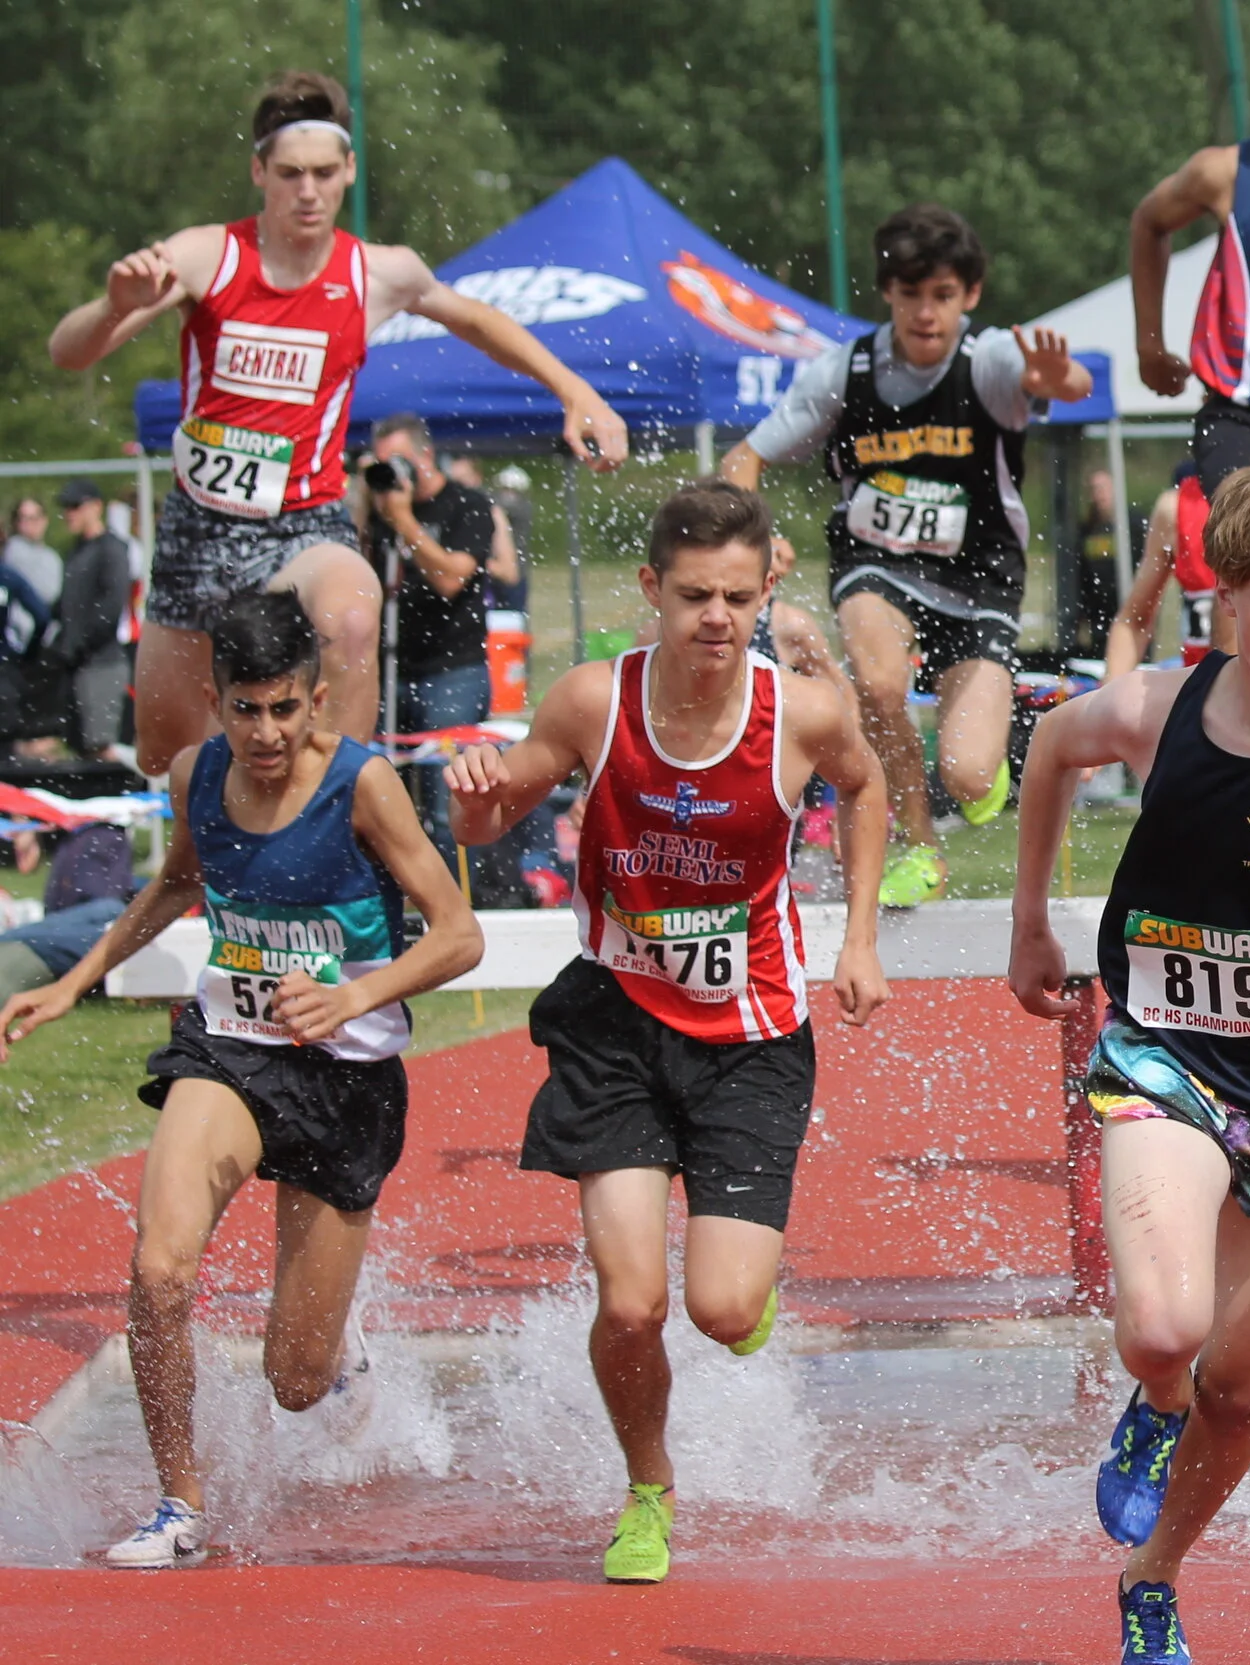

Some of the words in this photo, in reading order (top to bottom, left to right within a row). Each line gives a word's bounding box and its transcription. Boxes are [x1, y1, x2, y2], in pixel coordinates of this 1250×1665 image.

[229, 345, 309, 383] CENTRAL
[182, 419, 289, 458] SUBWAY
[188, 446, 260, 501] 224
[869, 470, 964, 504] SUBWAY
[872, 496, 938, 542] 578
[639, 831, 719, 861] SEMI
[603, 847, 746, 884] TOTEMS
[609, 905, 740, 937] SUBWAY
[217, 941, 333, 979] SUBWAY
[612, 954, 628, 968] BC
[632, 958, 646, 973] HS
[231, 975, 284, 1022] 52
[1143, 1007, 1160, 1022] BC
[1164, 1008, 1182, 1024] HS
[219, 1018, 233, 1032] BC
[235, 1020, 249, 1033] HS
